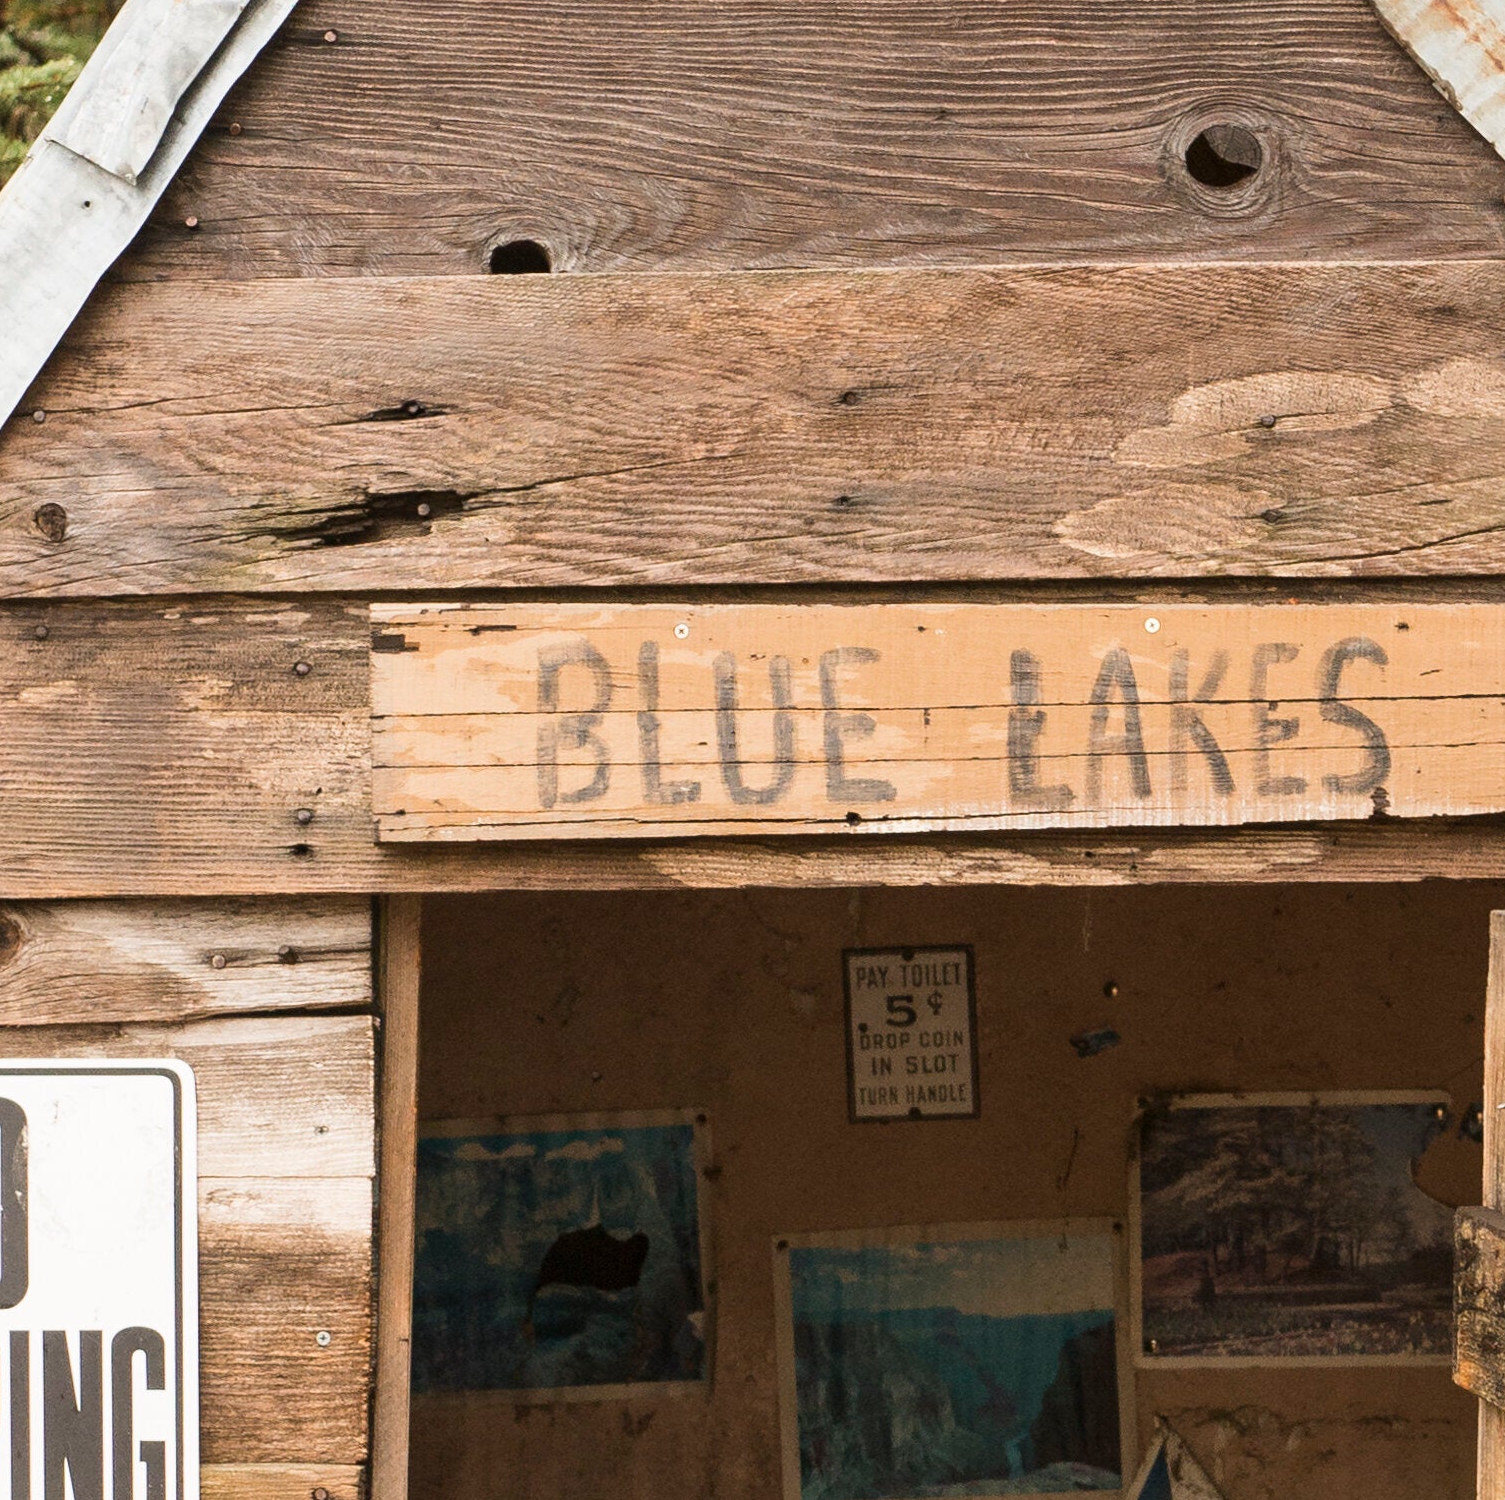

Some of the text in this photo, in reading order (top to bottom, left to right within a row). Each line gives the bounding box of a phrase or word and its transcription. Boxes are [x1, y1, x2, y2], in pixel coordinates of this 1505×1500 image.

[536, 635, 1392, 811] BLUE LAKES
[856, 962, 961, 988] PAY TOILET
[860, 1030, 964, 1051] DROP COIN
[871, 1054, 960, 1076] IN SLOT
[858, 1083, 967, 1106] TURN HANDLE
